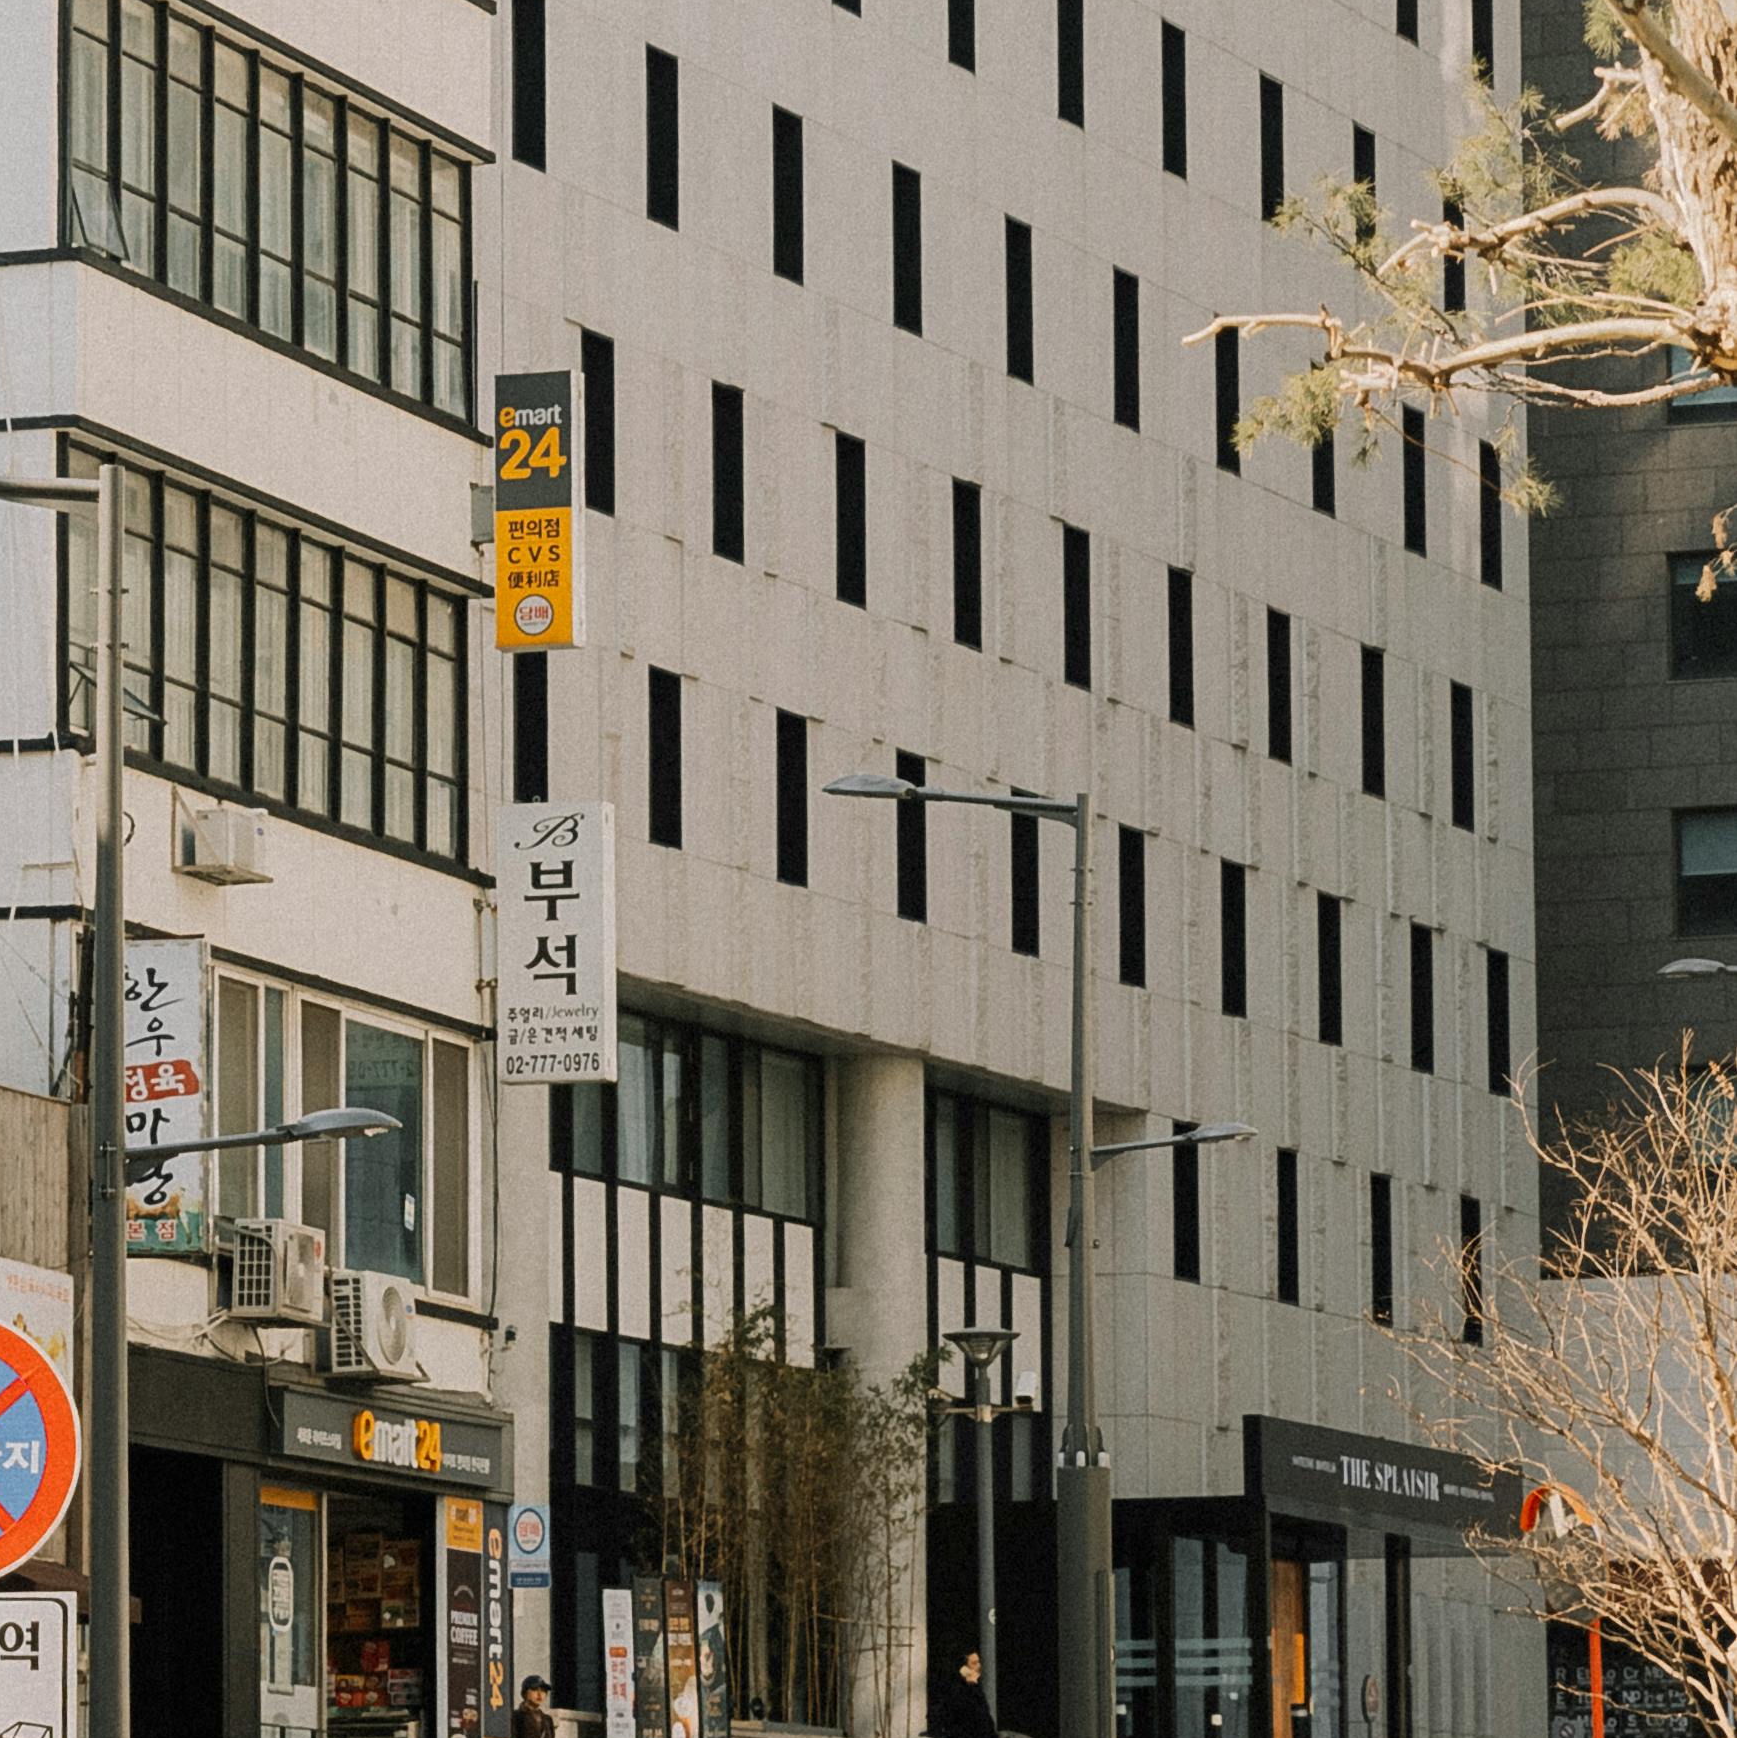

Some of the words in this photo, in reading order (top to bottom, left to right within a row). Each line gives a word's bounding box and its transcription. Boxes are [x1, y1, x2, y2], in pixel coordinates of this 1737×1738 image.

[499, 404, 562, 428] emart
[500, 427, 567, 480] 24
[508, 518, 560, 540] 편의점
[507, 569, 560, 589] 便利店
[519, 604, 549, 622] 담배
[524, 860, 580, 995] 부석
[507, 1026, 538, 1046] 금/은
[540, 1026, 568, 1044] 견적
[571, 1024, 598, 1043] 세팅
[506, 1052, 600, 1076] 02-777-0976
[1339, 1455, 1372, 1490] THE
[1374, 1462, 1440, 1503] SPLAISIR
